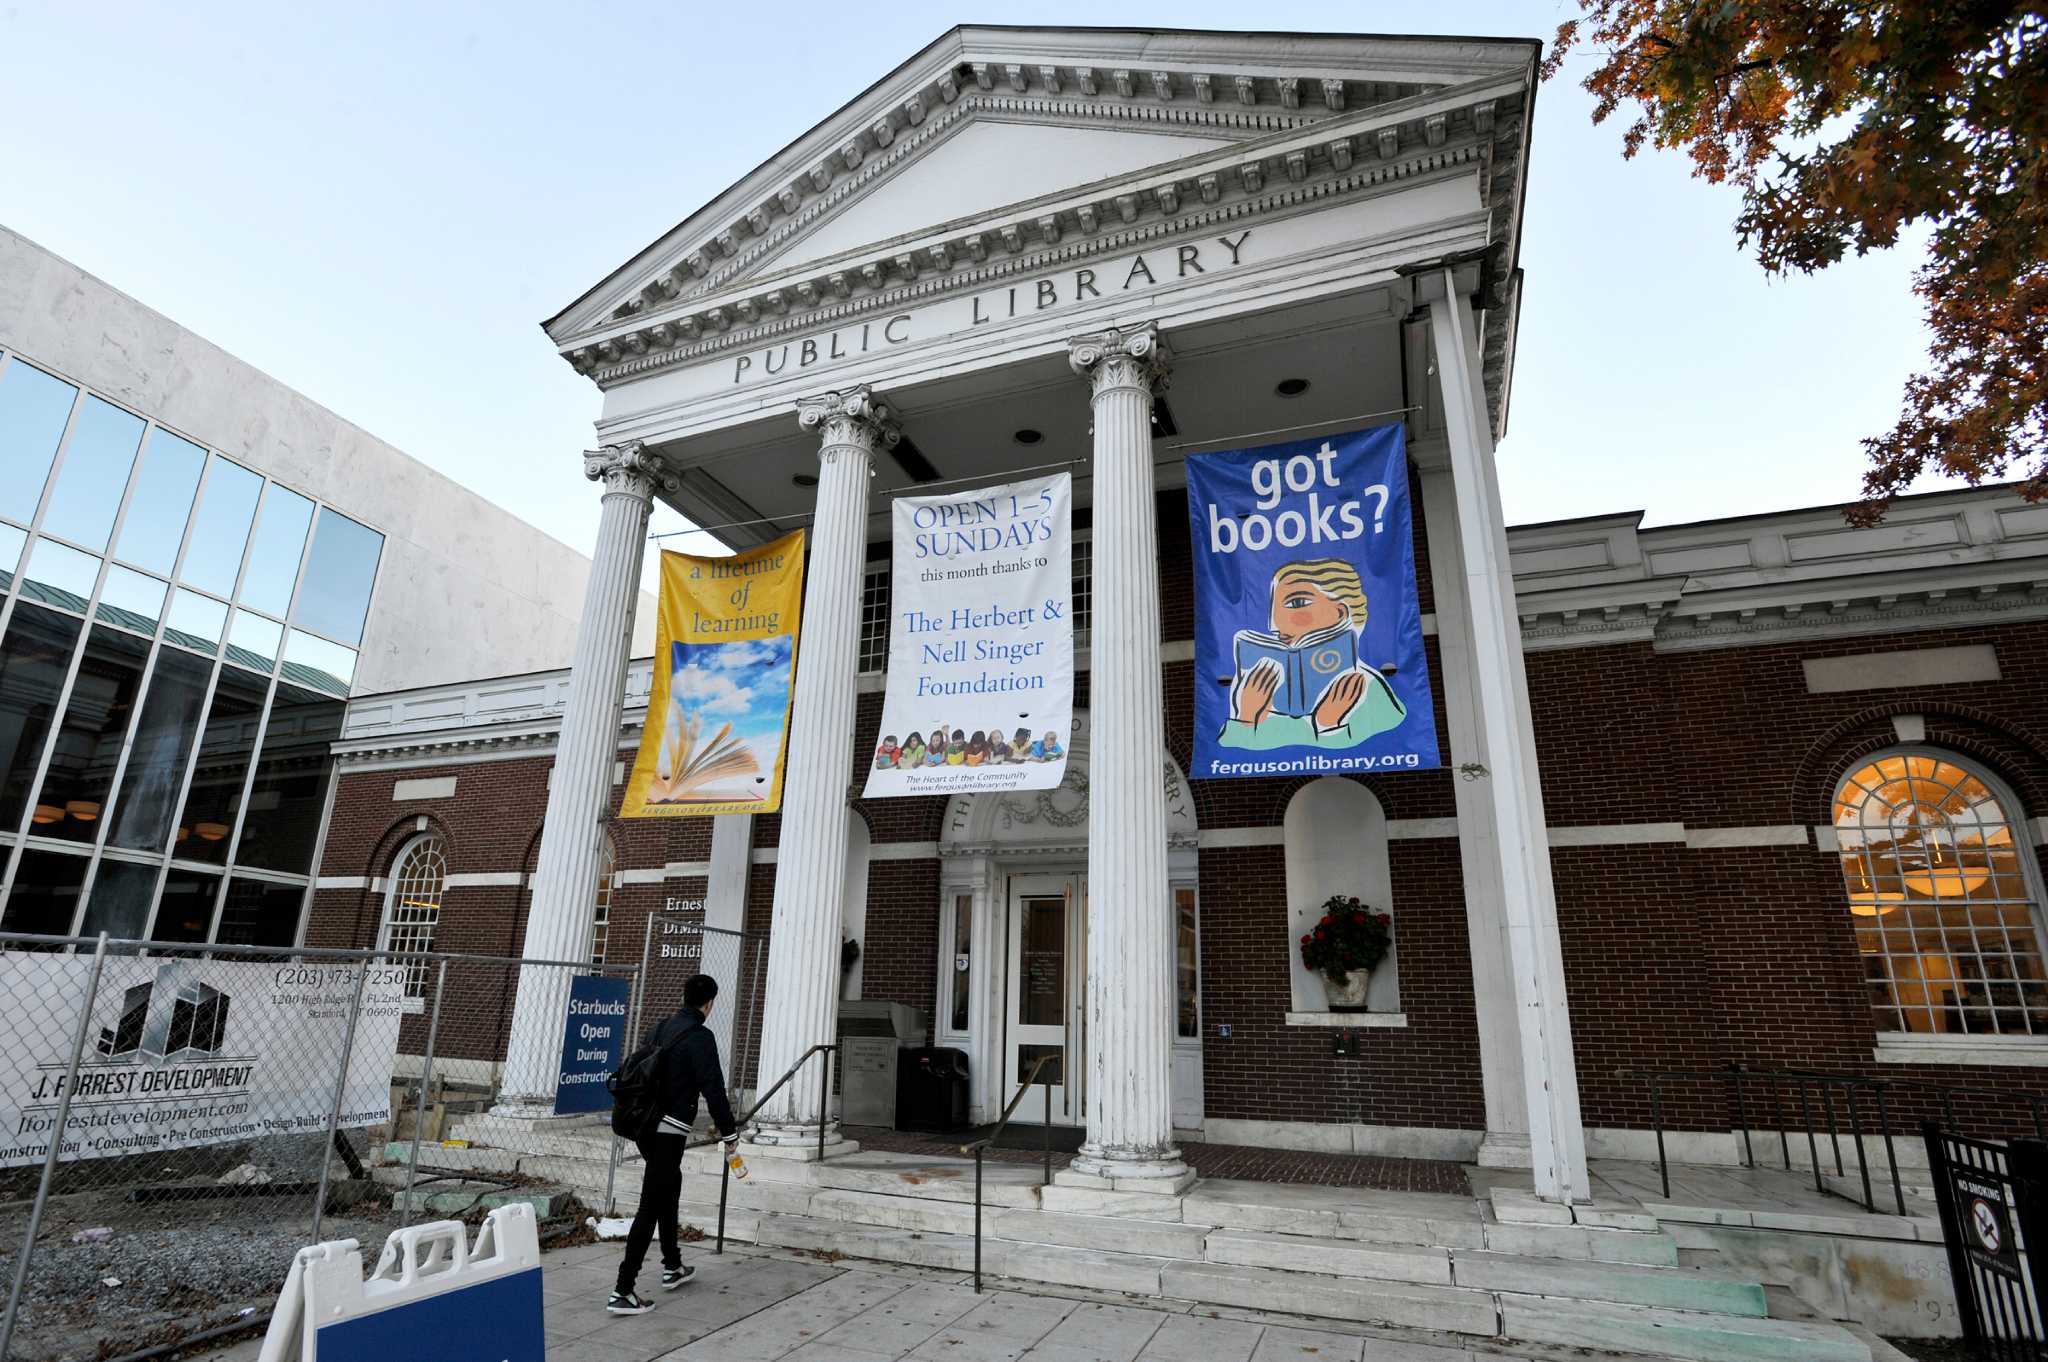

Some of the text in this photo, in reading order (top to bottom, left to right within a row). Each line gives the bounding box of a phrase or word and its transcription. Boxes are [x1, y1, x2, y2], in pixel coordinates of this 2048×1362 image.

[734, 231, 1252, 384] PUBLIC LIBRARY
[1251, 441, 1340, 510] got
[913, 497, 997, 529] OPEN
[1208, 484, 1390, 553] books?
[915, 516, 1053, 558] SUNDAYS
[690, 554, 785, 579] a lifetime
[920, 556, 1048, 582] this month thanks to
[730, 580, 754, 611] of
[693, 610, 780, 634] learning
[904, 599, 1064, 633] The Herbert &
[921, 638, 1045, 665] Nell Singer
[916, 671, 1046, 697] Foundation
[1211, 752, 1420, 774] fergusonlibrary.org
[907, 775, 920, 783] The
[961, 774, 975, 782] the
[977, 771, 1027, 781] Community
[951, 792, 976, 832] TH
[275, 968, 324, 989] (203)
[272, 994, 299, 1005] 1200
[366, 1007, 399, 1017] 06905
[569, 999, 626, 1015] Starbucks
[580, 1023, 611, 1042] Open
[576, 1048, 608, 1063] During
[32, 1075, 48, 1099] J.
[140, 1066, 254, 1092] DEVELOPMENT
[559, 1069, 617, 1085] Constructi
[18, 1102, 249, 1138] Jforestdevelopment.com
[0, 1140, 80, 1160] onstruion
[95, 1131, 160, 1151] Consulting
[169, 1129, 188, 1143] Pre
[189, 1121, 256, 1140] Construction
[1957, 1179, 2001, 1201] NO SMOKING
